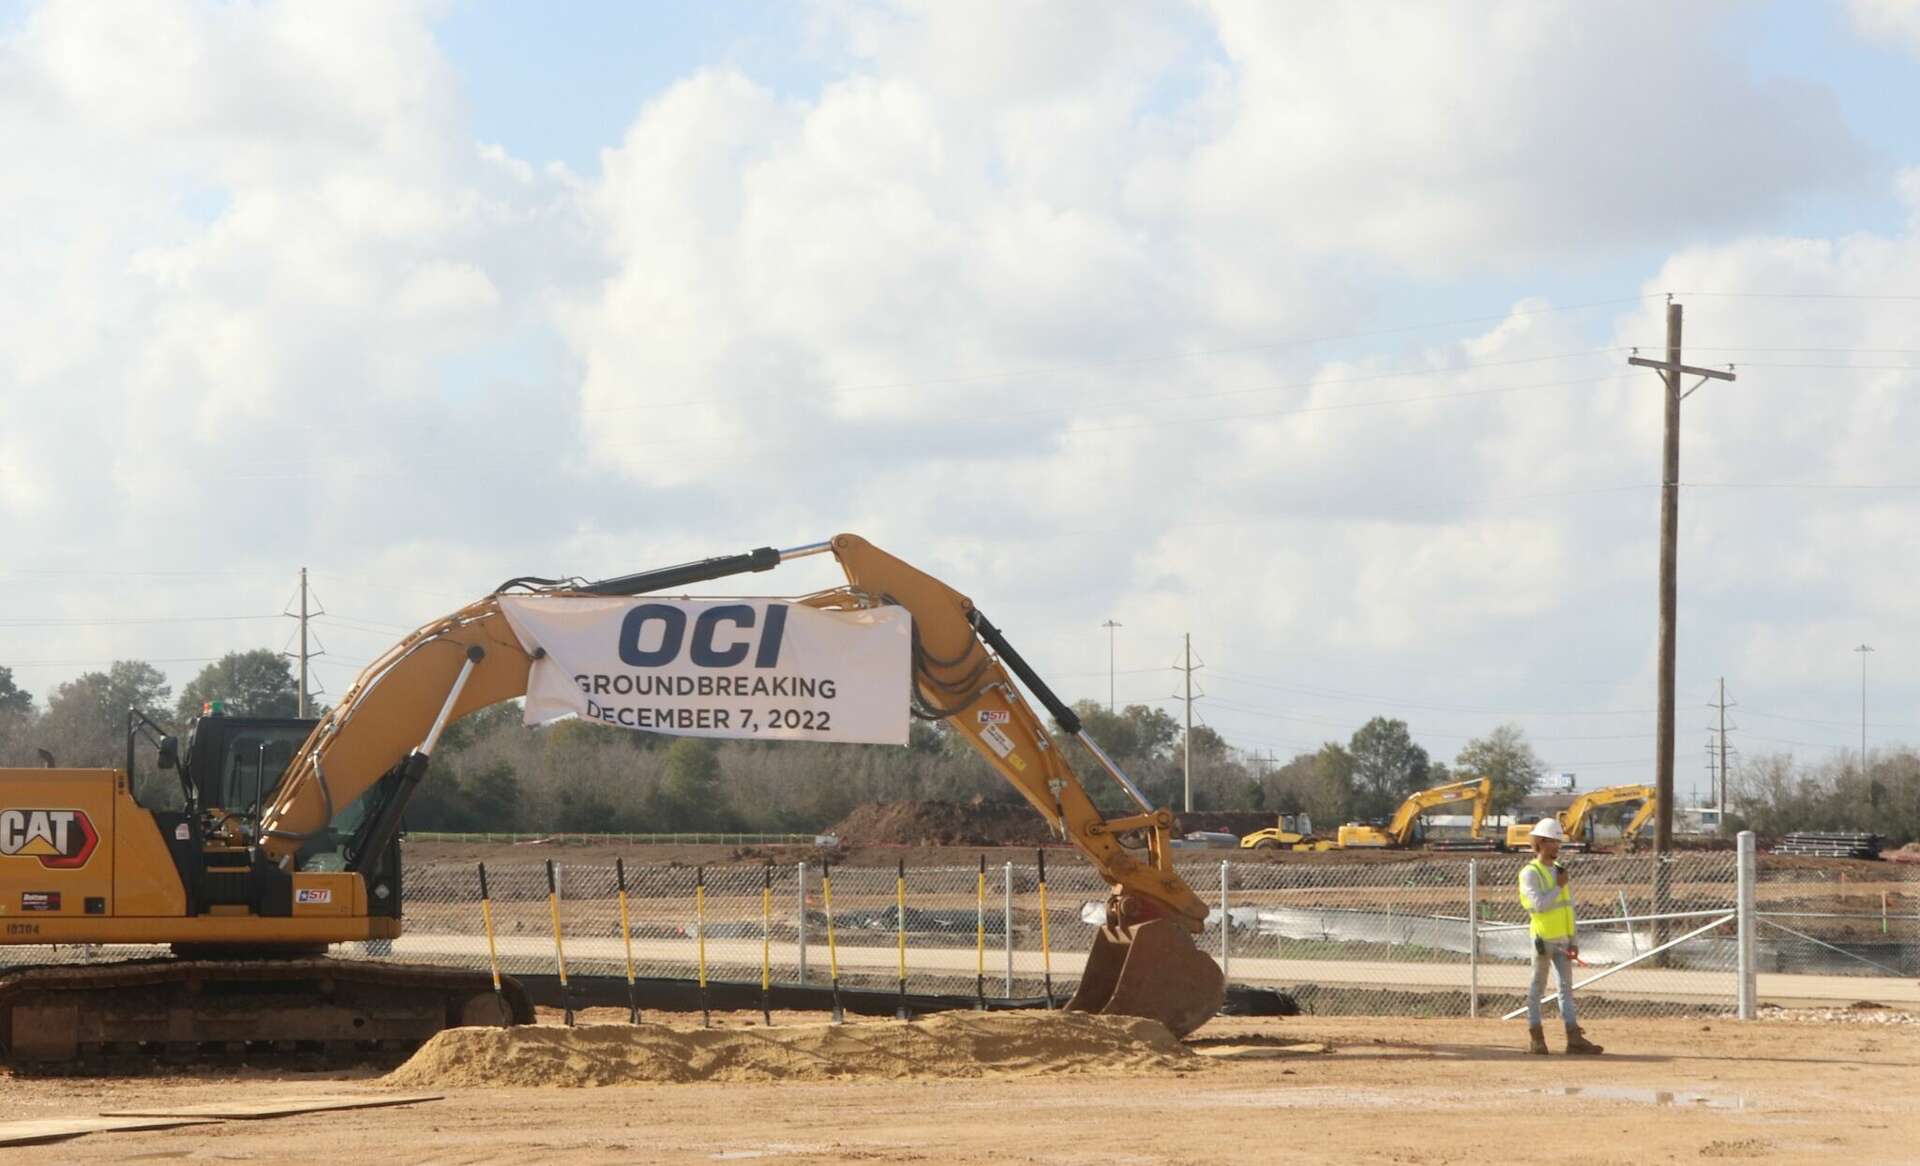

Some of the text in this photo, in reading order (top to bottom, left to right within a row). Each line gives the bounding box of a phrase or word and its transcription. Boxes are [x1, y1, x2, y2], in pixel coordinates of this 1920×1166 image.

[618, 604, 789, 668] OCI
[574, 674, 837, 699] GROUNDBREAKING
[587, 699, 831, 733] DECEMBER 7, 2022
[0, 811, 74, 855] CAT
